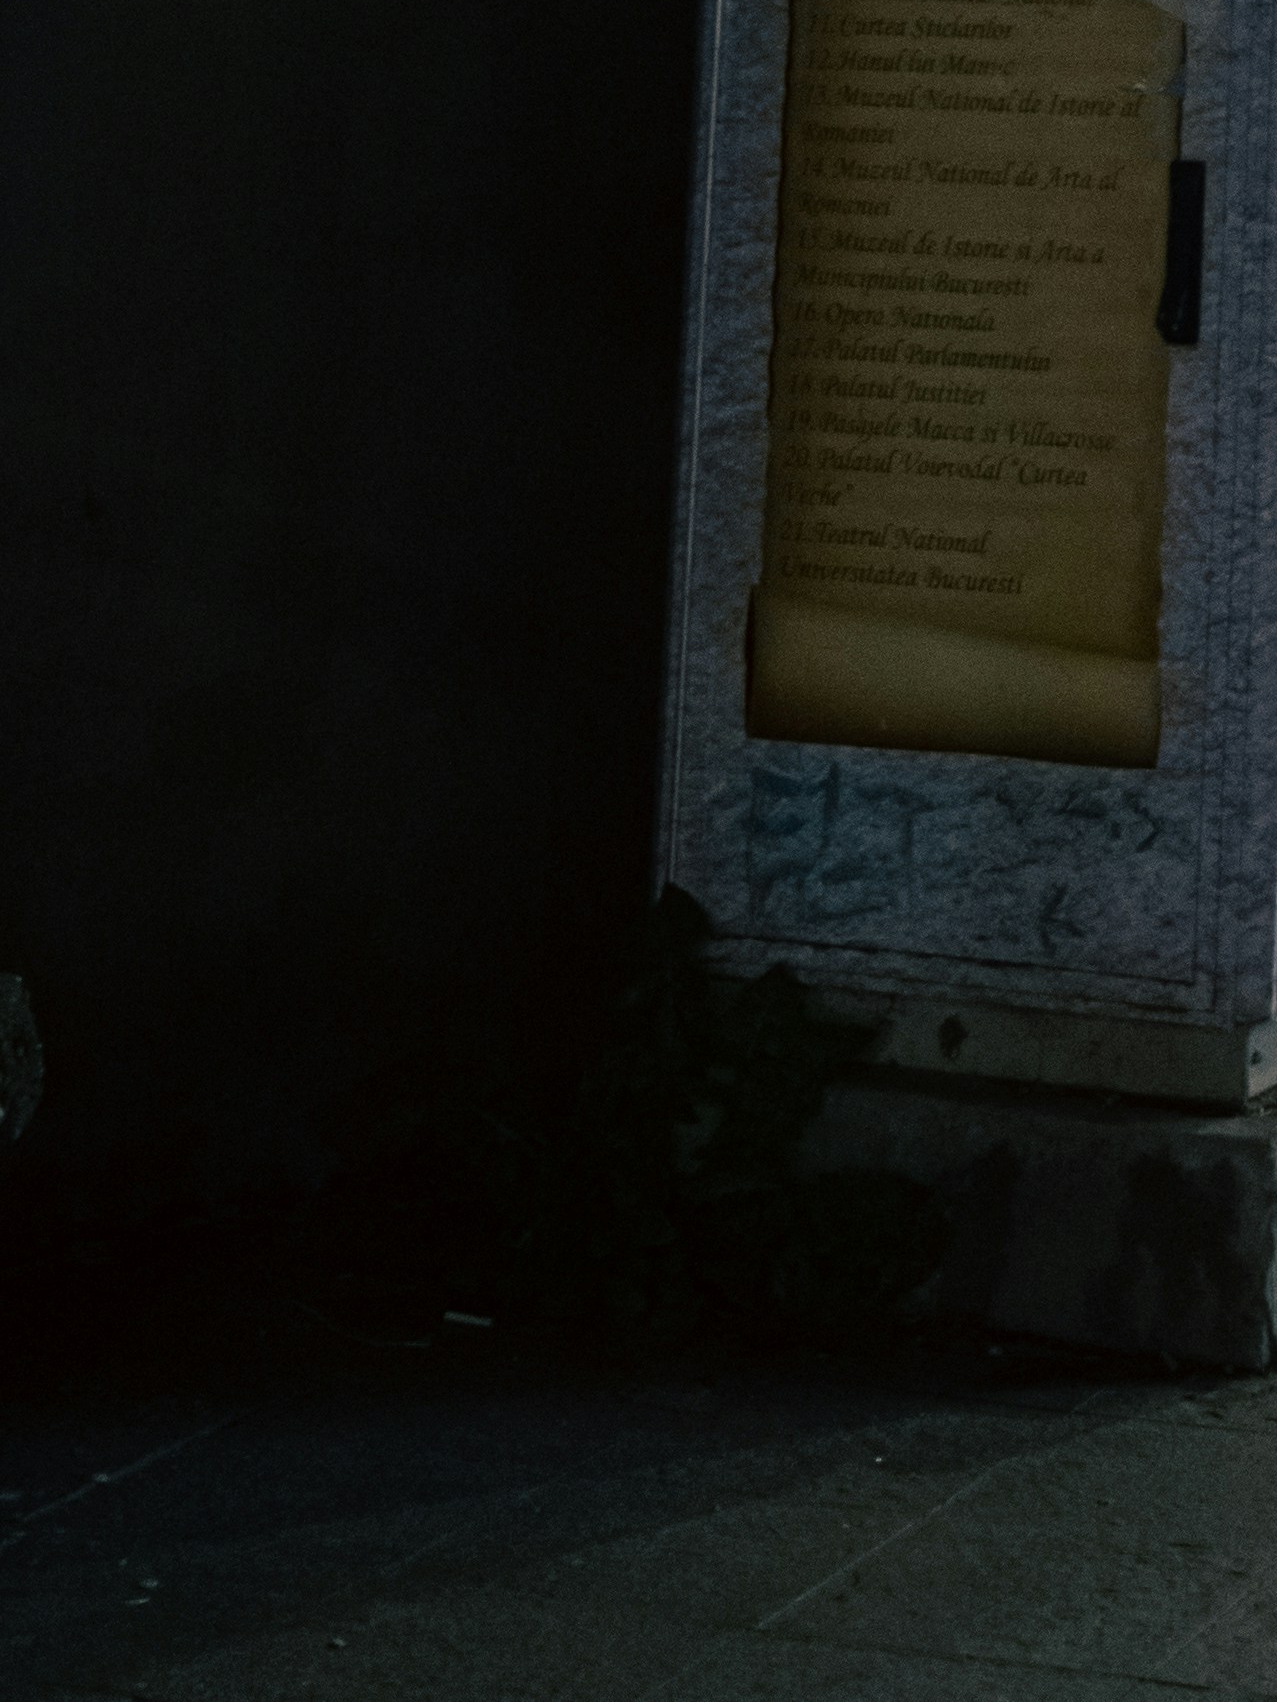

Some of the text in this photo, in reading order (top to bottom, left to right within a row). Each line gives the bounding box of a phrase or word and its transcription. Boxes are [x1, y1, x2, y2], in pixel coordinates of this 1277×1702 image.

[1019, 89, 1042, 113] de
[1048, 91, 1117, 118] Istorie
[1120, 94, 1144, 119] al
[918, 160, 1013, 188] National
[1014, 162, 1040, 187] de
[1043, 166, 1093, 191] Arta
[1097, 166, 1124, 192] al
[913, 231, 937, 256] de
[942, 232, 1009, 260] Istorie
[1035, 239, 1088, 264] Arta
[904, 343, 1053, 372] Parlamentului
